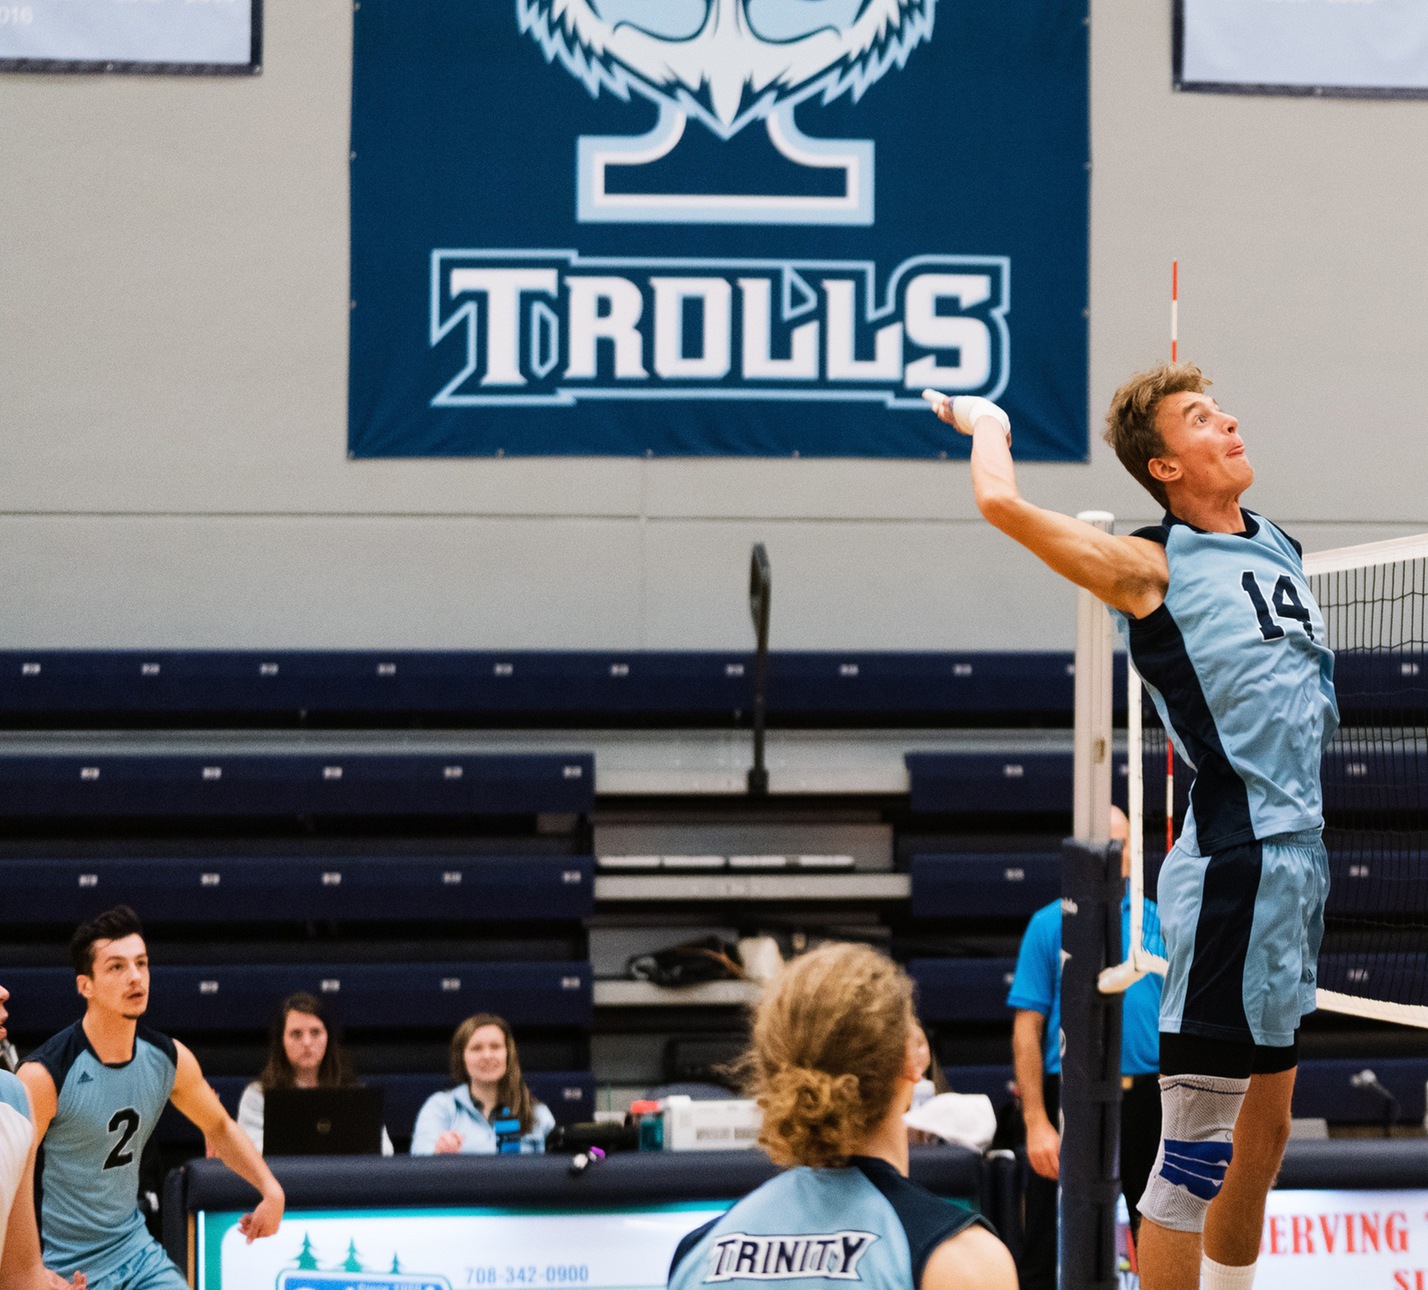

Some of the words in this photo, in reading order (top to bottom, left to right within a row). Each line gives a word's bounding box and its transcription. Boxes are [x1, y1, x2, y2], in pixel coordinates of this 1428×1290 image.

[0, 5, 34, 25] 016
[446, 265, 994, 391] TROLLS
[1241, 570, 1315, 642] 14
[103, 1108, 141, 1171] 2
[1259, 1210, 1410, 1255] ERVING
[465, 1264, 590, 1284] 708-342-0900
[714, 1235, 868, 1278] TRINITY
